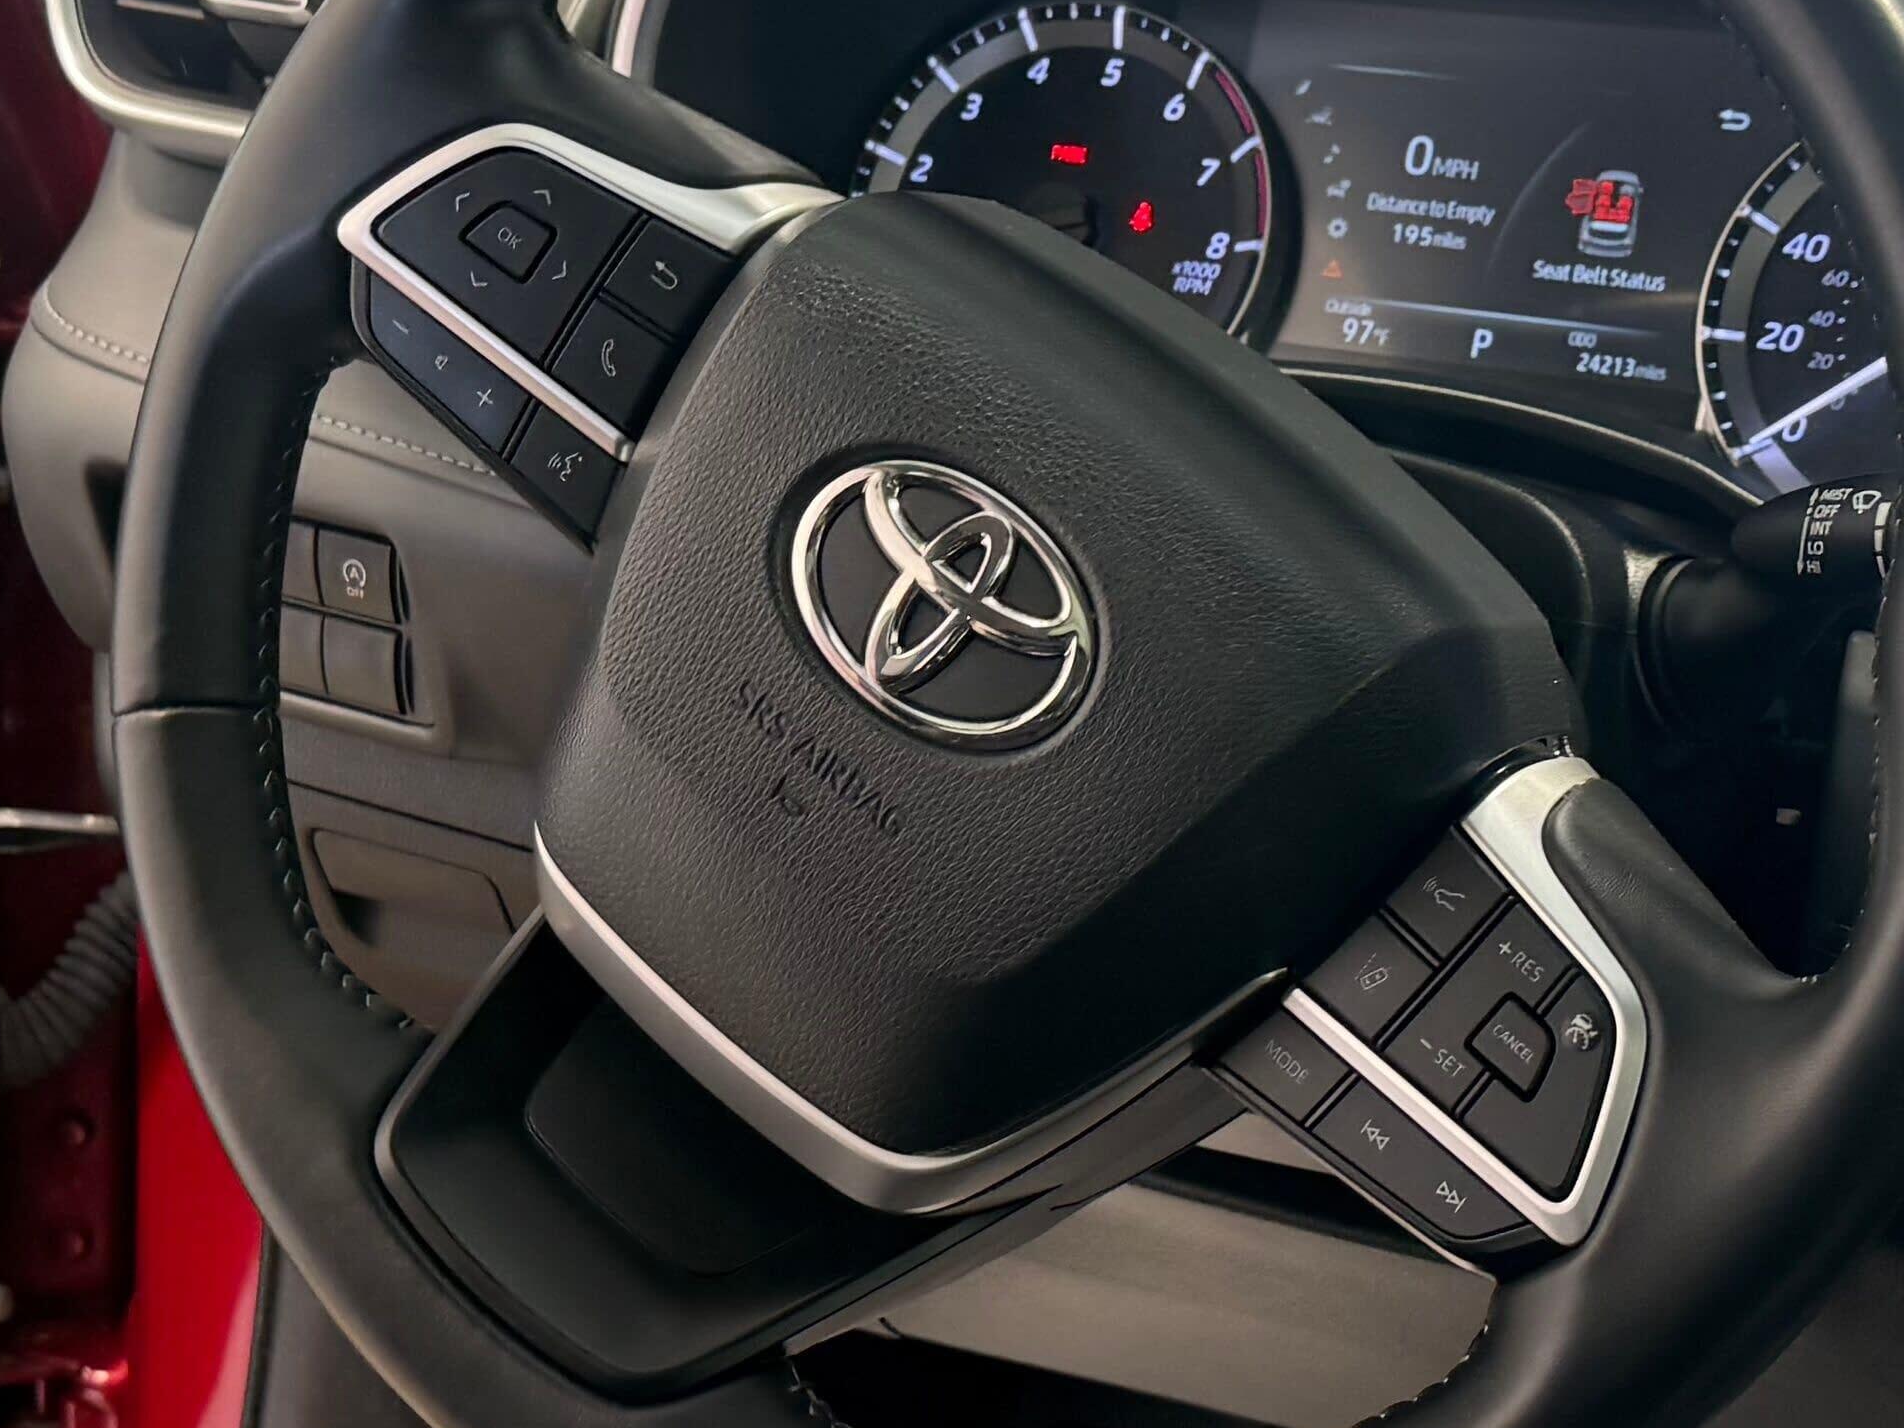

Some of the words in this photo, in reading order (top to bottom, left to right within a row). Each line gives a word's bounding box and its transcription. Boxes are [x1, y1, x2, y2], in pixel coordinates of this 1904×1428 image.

[1027, 57, 1051, 84] 4
[1101, 58, 1124, 87] 5
[960, 93, 983, 121] 3
[1163, 93, 1186, 121] 6
[909, 154, 934, 183] 2
[1197, 159, 1221, 187] 7
[1447, 202, 1495, 226] Empty
[497, 227, 522, 250] OK
[1205, 232, 1230, 260] 8
[1782, 232, 1831, 263] 40
[1532, 259, 1570, 281] Seat
[1572, 263, 1608, 286] Belt
[1609, 268, 1665, 292] Status
[1821, 269, 1850, 288] 60
[1808, 309, 1836, 328] 40
[1470, 328, 1493, 359] P
[1756, 321, 1805, 353] 20
[1807, 351, 1835, 370] 20
[1813, 504, 1841, 519] OFF
[1510, 948, 1543, 983] RES
[1492, 1023, 1535, 1065] CANCEL
[1265, 1038, 1310, 1086] MODE
[1434, 1047, 1465, 1077] SET
